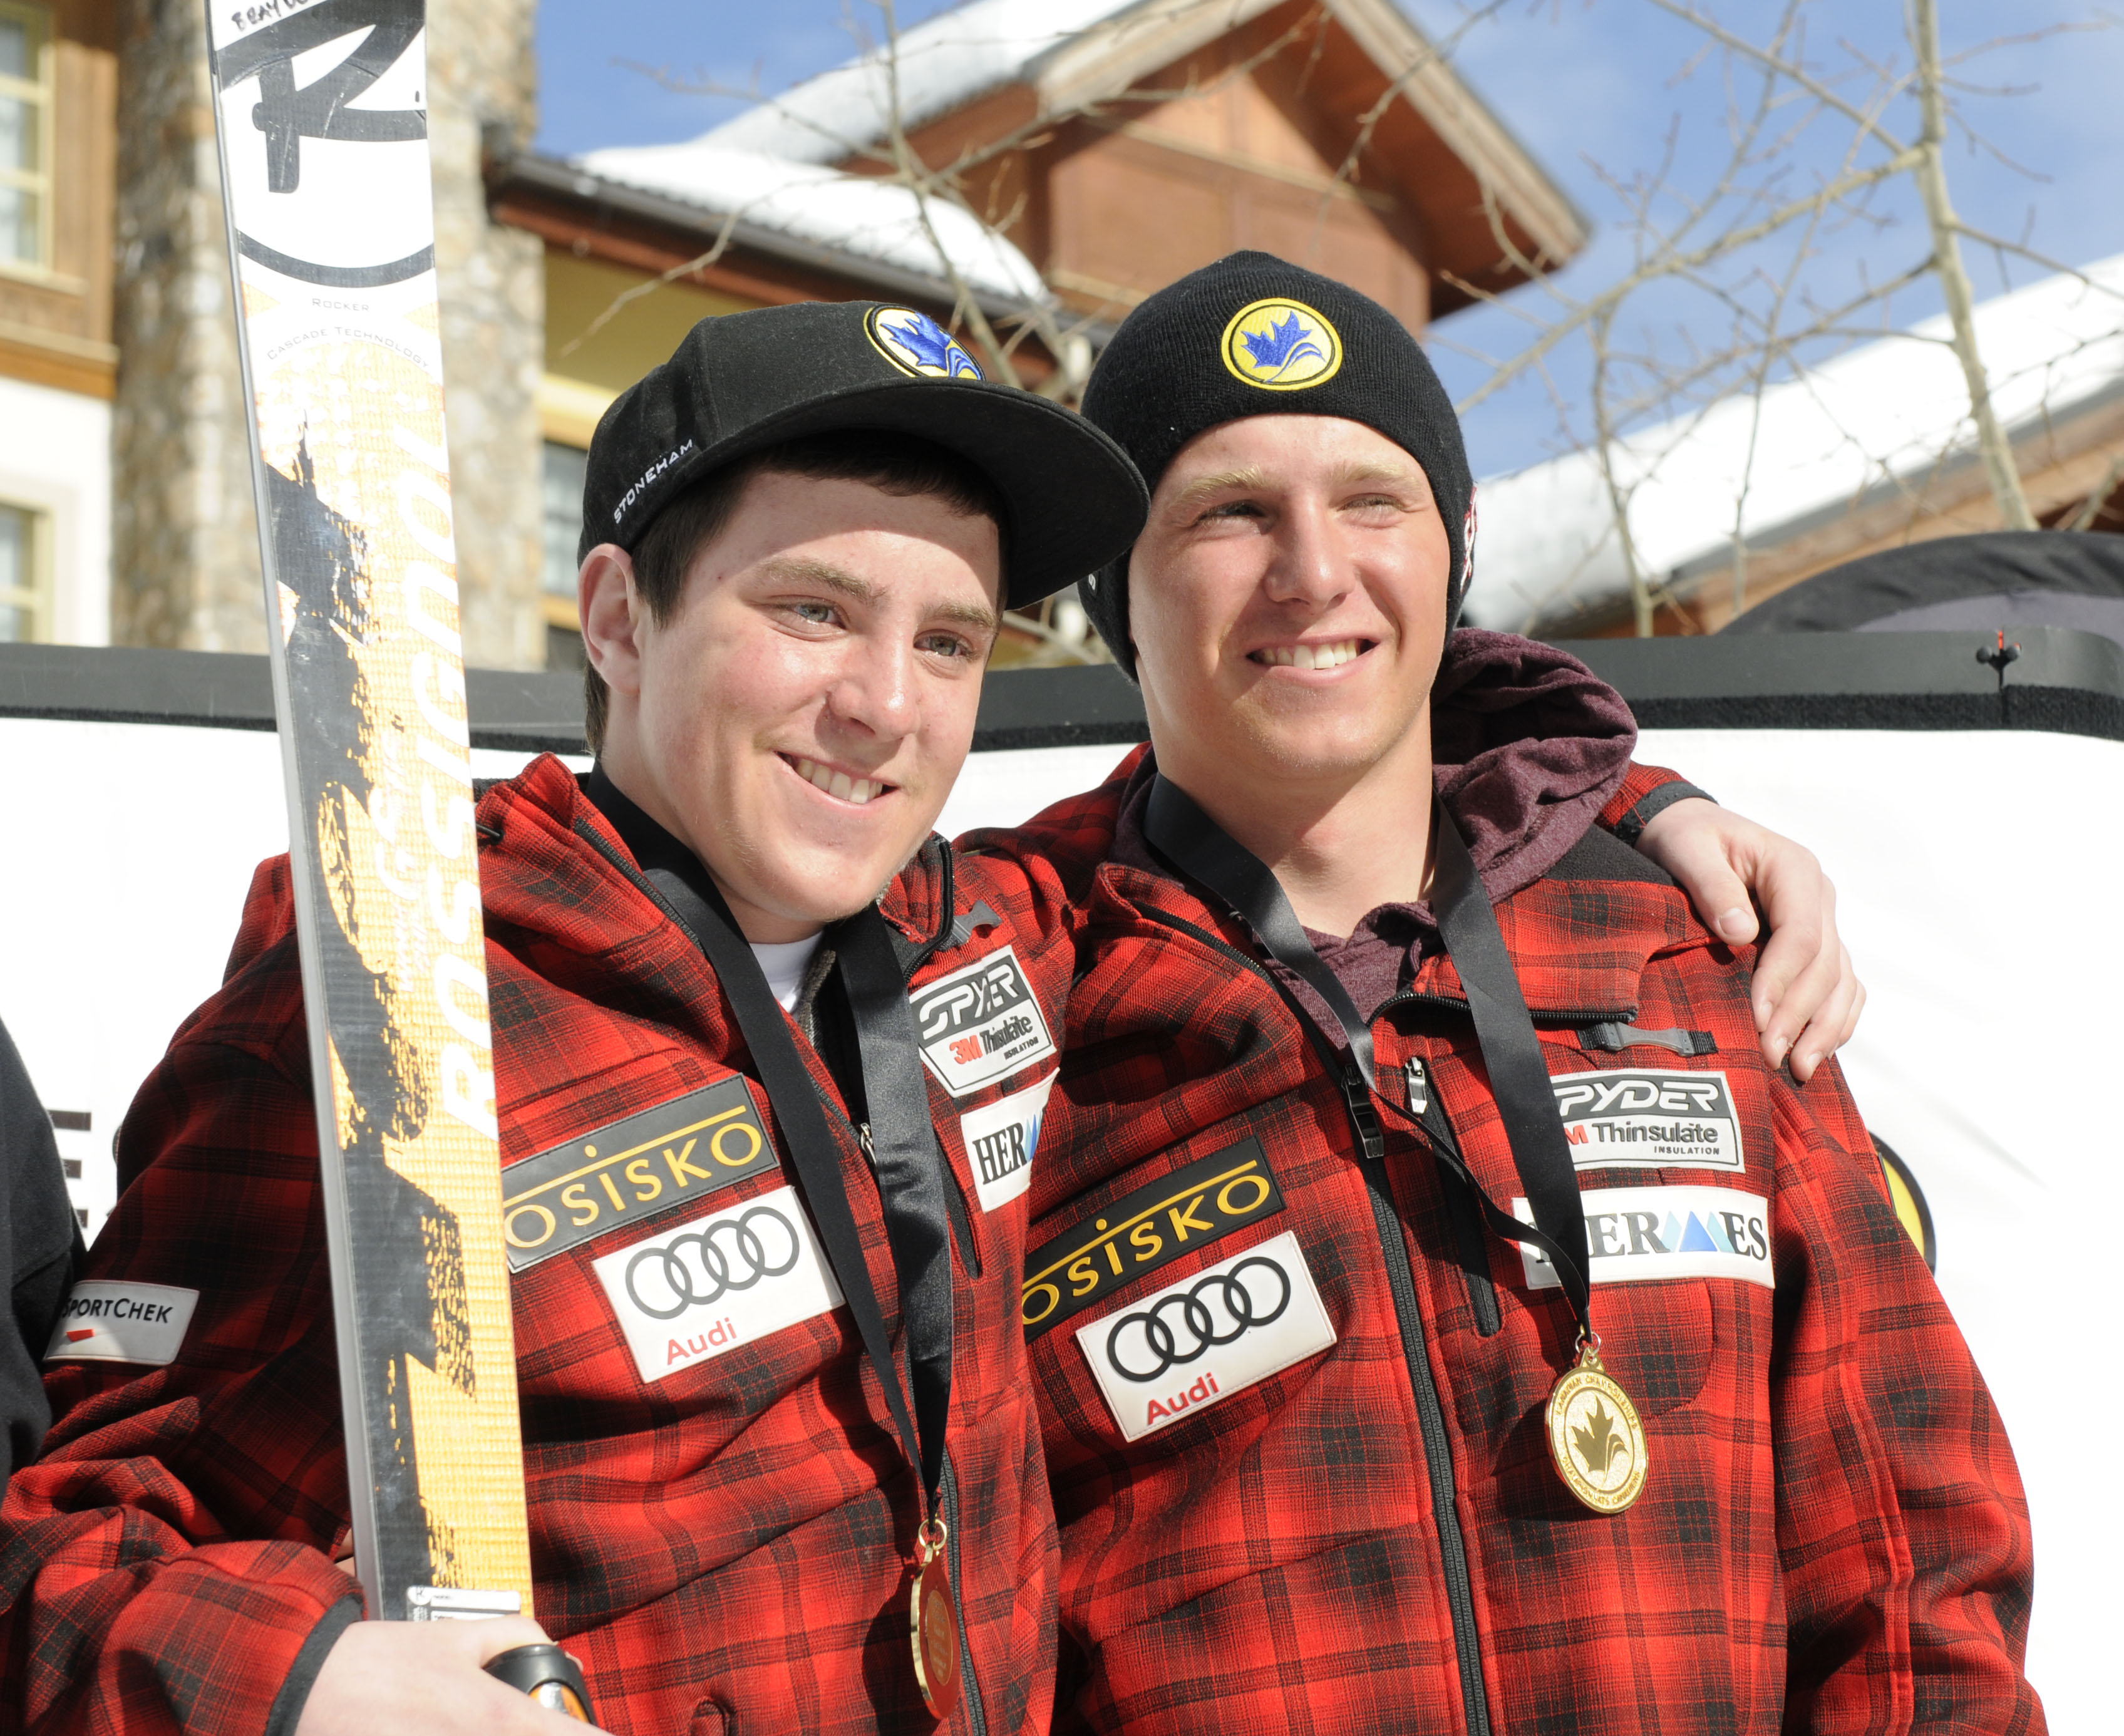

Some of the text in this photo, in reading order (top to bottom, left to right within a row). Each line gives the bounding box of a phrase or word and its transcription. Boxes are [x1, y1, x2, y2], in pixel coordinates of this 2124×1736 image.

[312, 297, 370, 311] ROCKER
[267, 326, 429, 368] CASCADE TECHNOLOGY
[614, 438, 693, 524] STONEHAM
[919, 964, 1019, 1040] SPYER
[949, 1035, 983, 1065] 3M
[1554, 1080, 1719, 1117] PYDER
[1592, 1120, 1718, 1144] Thinsulate
[1654, 1145, 1720, 1155] INSULATION
[503, 1122, 762, 1248] OSISKO
[1021, 1175, 1270, 1326] OSISKO
[666, 1316, 738, 1366] Audi
[1146, 1372, 1220, 1426] Audi
